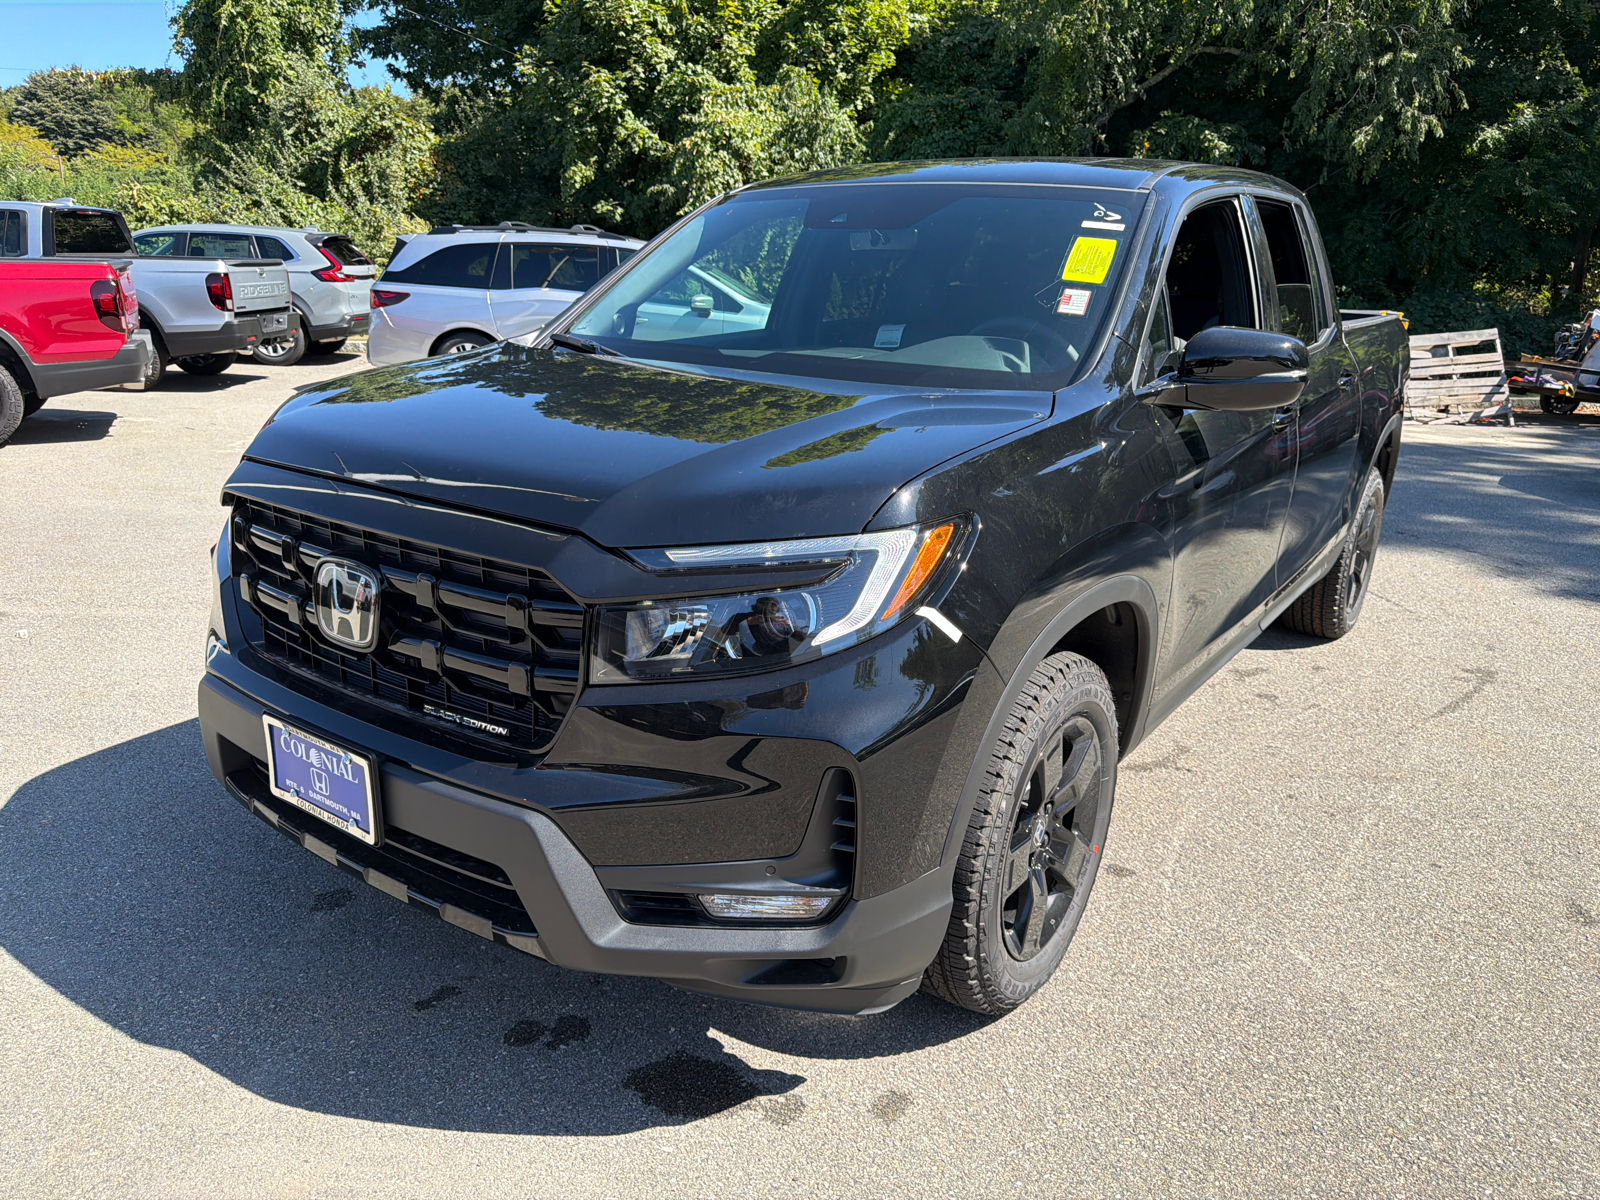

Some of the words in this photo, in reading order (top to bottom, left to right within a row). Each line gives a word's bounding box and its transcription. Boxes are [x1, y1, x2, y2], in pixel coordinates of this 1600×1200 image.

[423, 705, 461, 723] BLACK
[462, 716, 508, 736] EDITION
[280, 735, 358, 784] COLONIAL
[285, 778, 300, 791] RTE.
[300, 786, 305, 794] 6
[308, 790, 350, 817] DARTMOUTH,
[350, 811, 362, 821] MA
[296, 798, 326, 820] COLONIAL
[326, 813, 350, 831] HONDA
